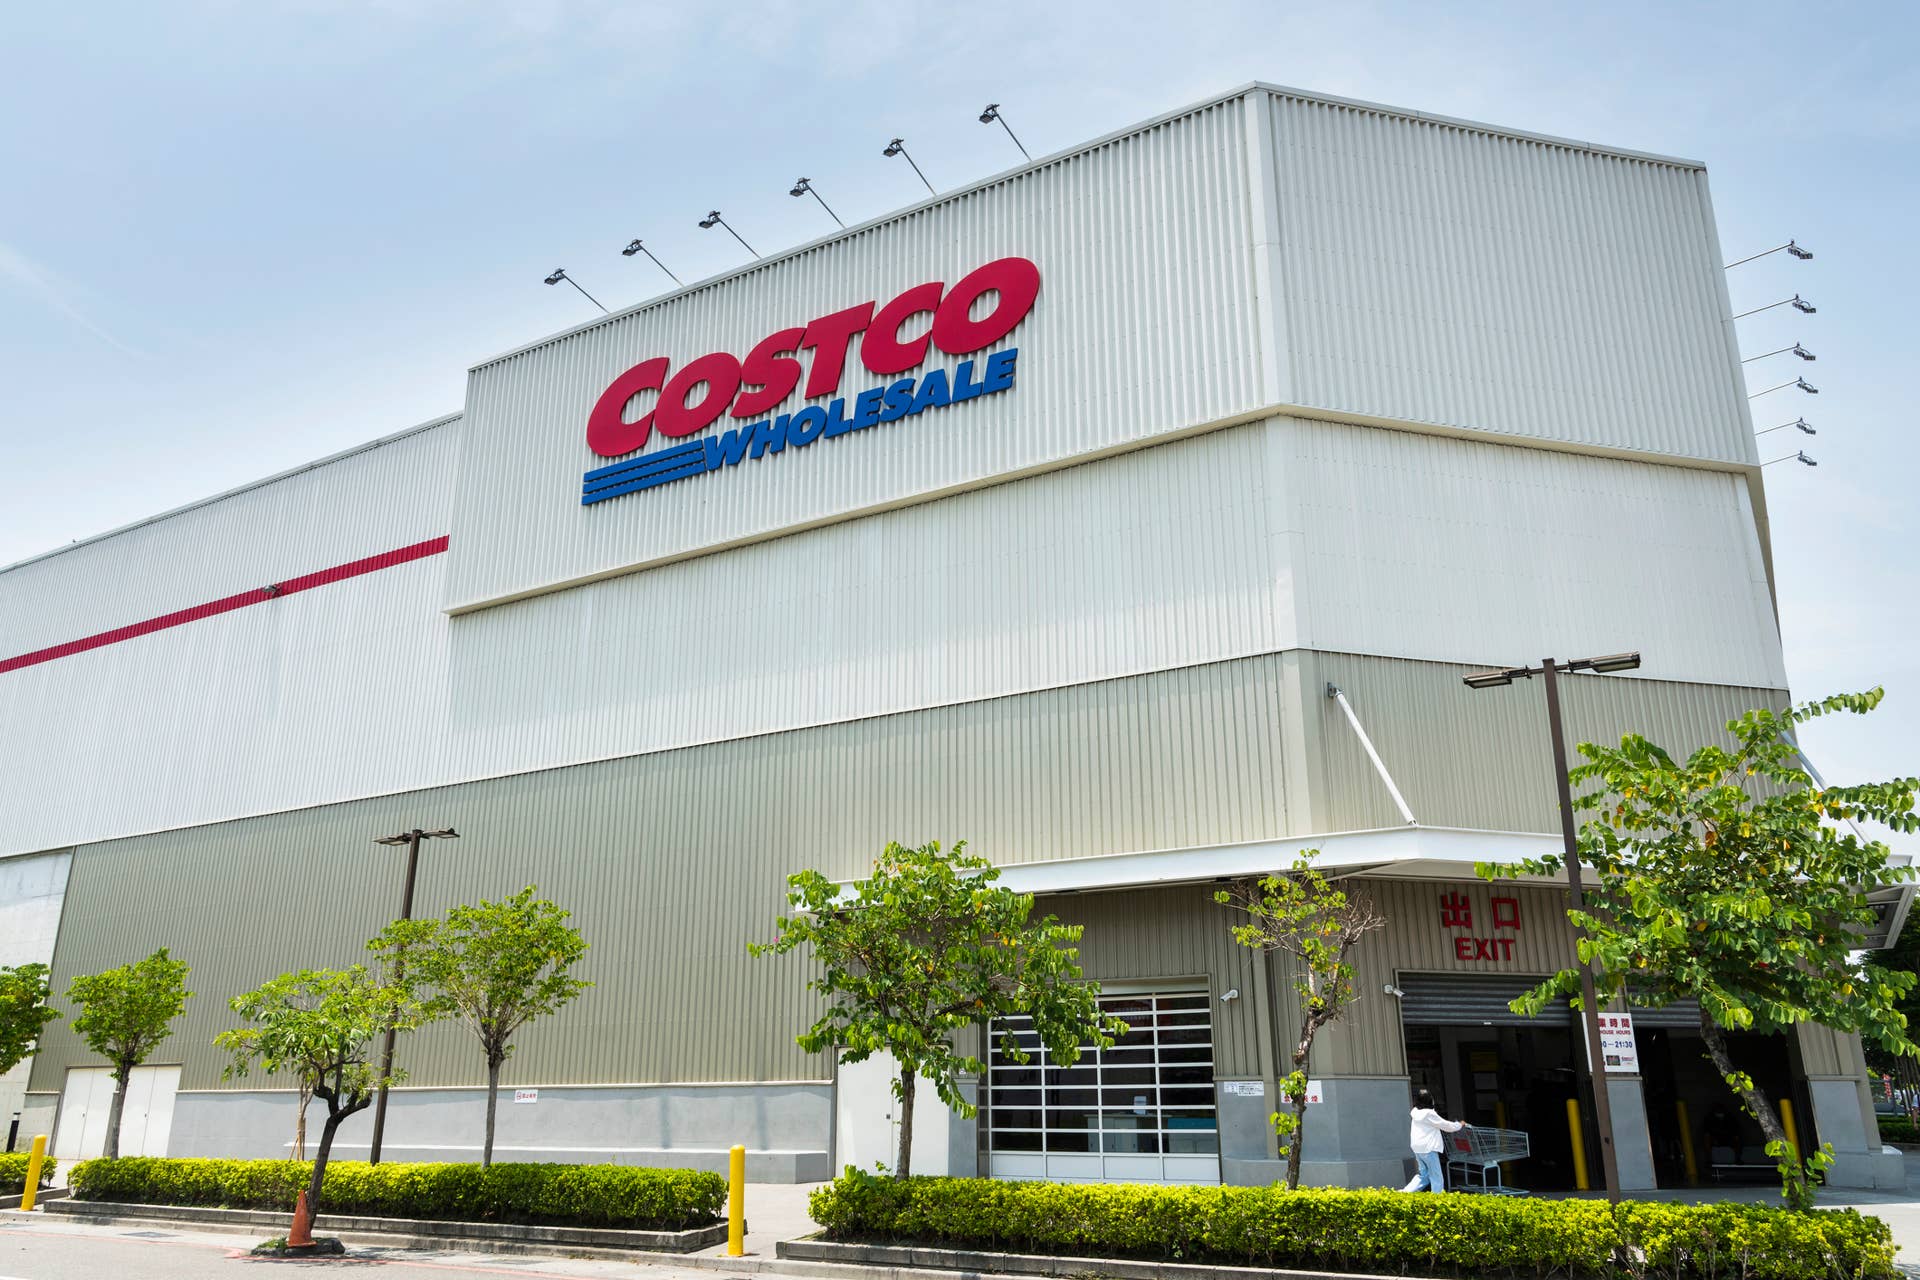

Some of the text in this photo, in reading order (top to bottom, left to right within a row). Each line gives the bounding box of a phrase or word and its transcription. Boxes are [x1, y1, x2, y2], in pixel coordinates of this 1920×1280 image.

[586, 256, 1041, 457] COSTCO
[702, 347, 1018, 471] WHOLESALE
[1441, 892, 1521, 930] 出口
[1455, 937, 1515, 961] EXIT
